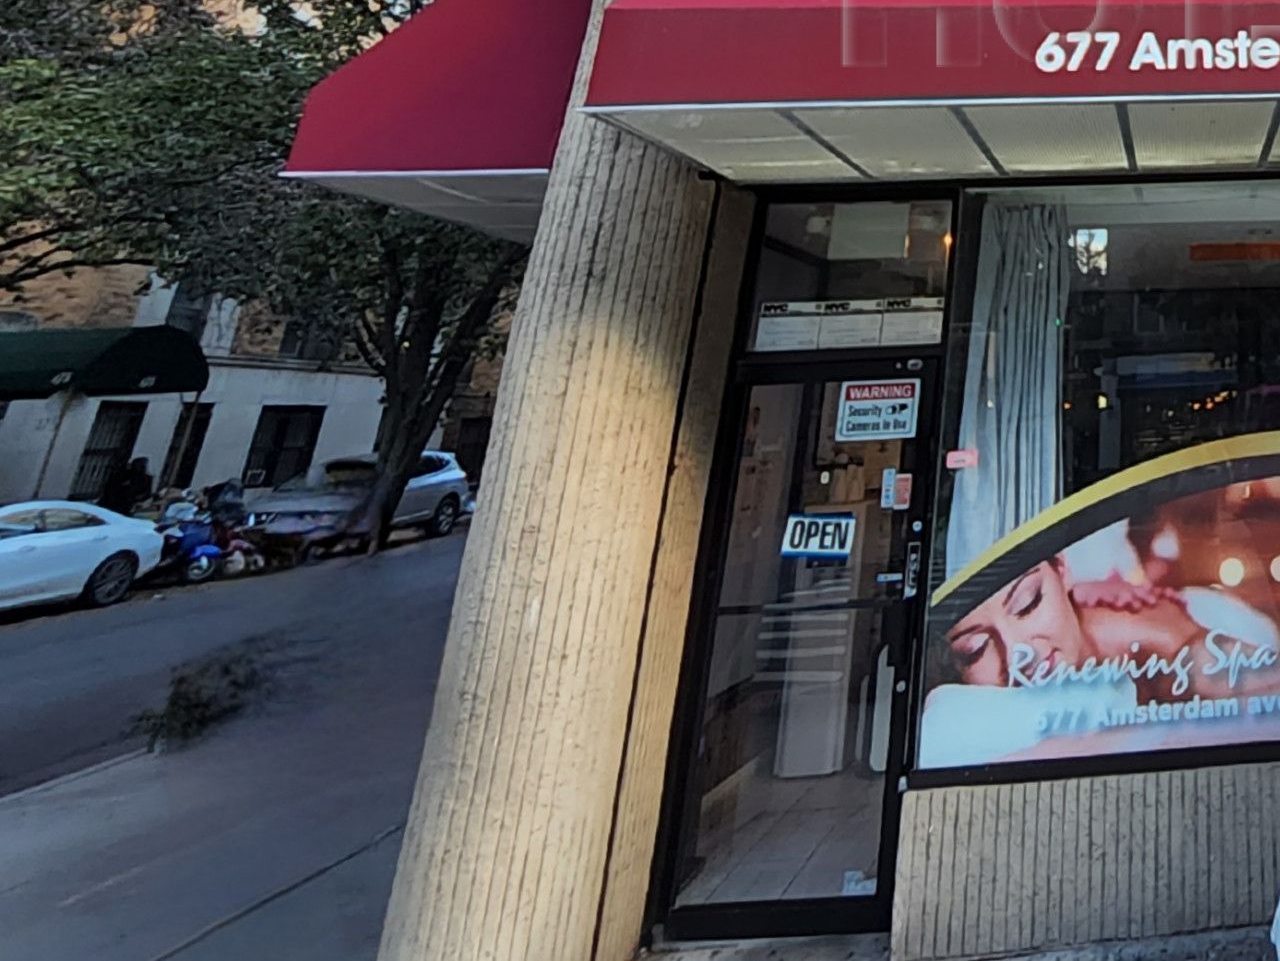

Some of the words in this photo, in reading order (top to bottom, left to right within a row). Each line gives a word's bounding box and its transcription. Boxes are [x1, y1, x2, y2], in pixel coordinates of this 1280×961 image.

[1035, 31, 1121, 73] 677
[848, 384, 912, 400] WARNING
[846, 420, 881, 432] Cameras
[848, 404, 882, 417] Security
[789, 519, 851, 551] OPEN
[1006, 641, 1194, 696] Renewing
[1202, 628, 1278, 689] Spa
[1098, 695, 1239, 729] Amsterdam
